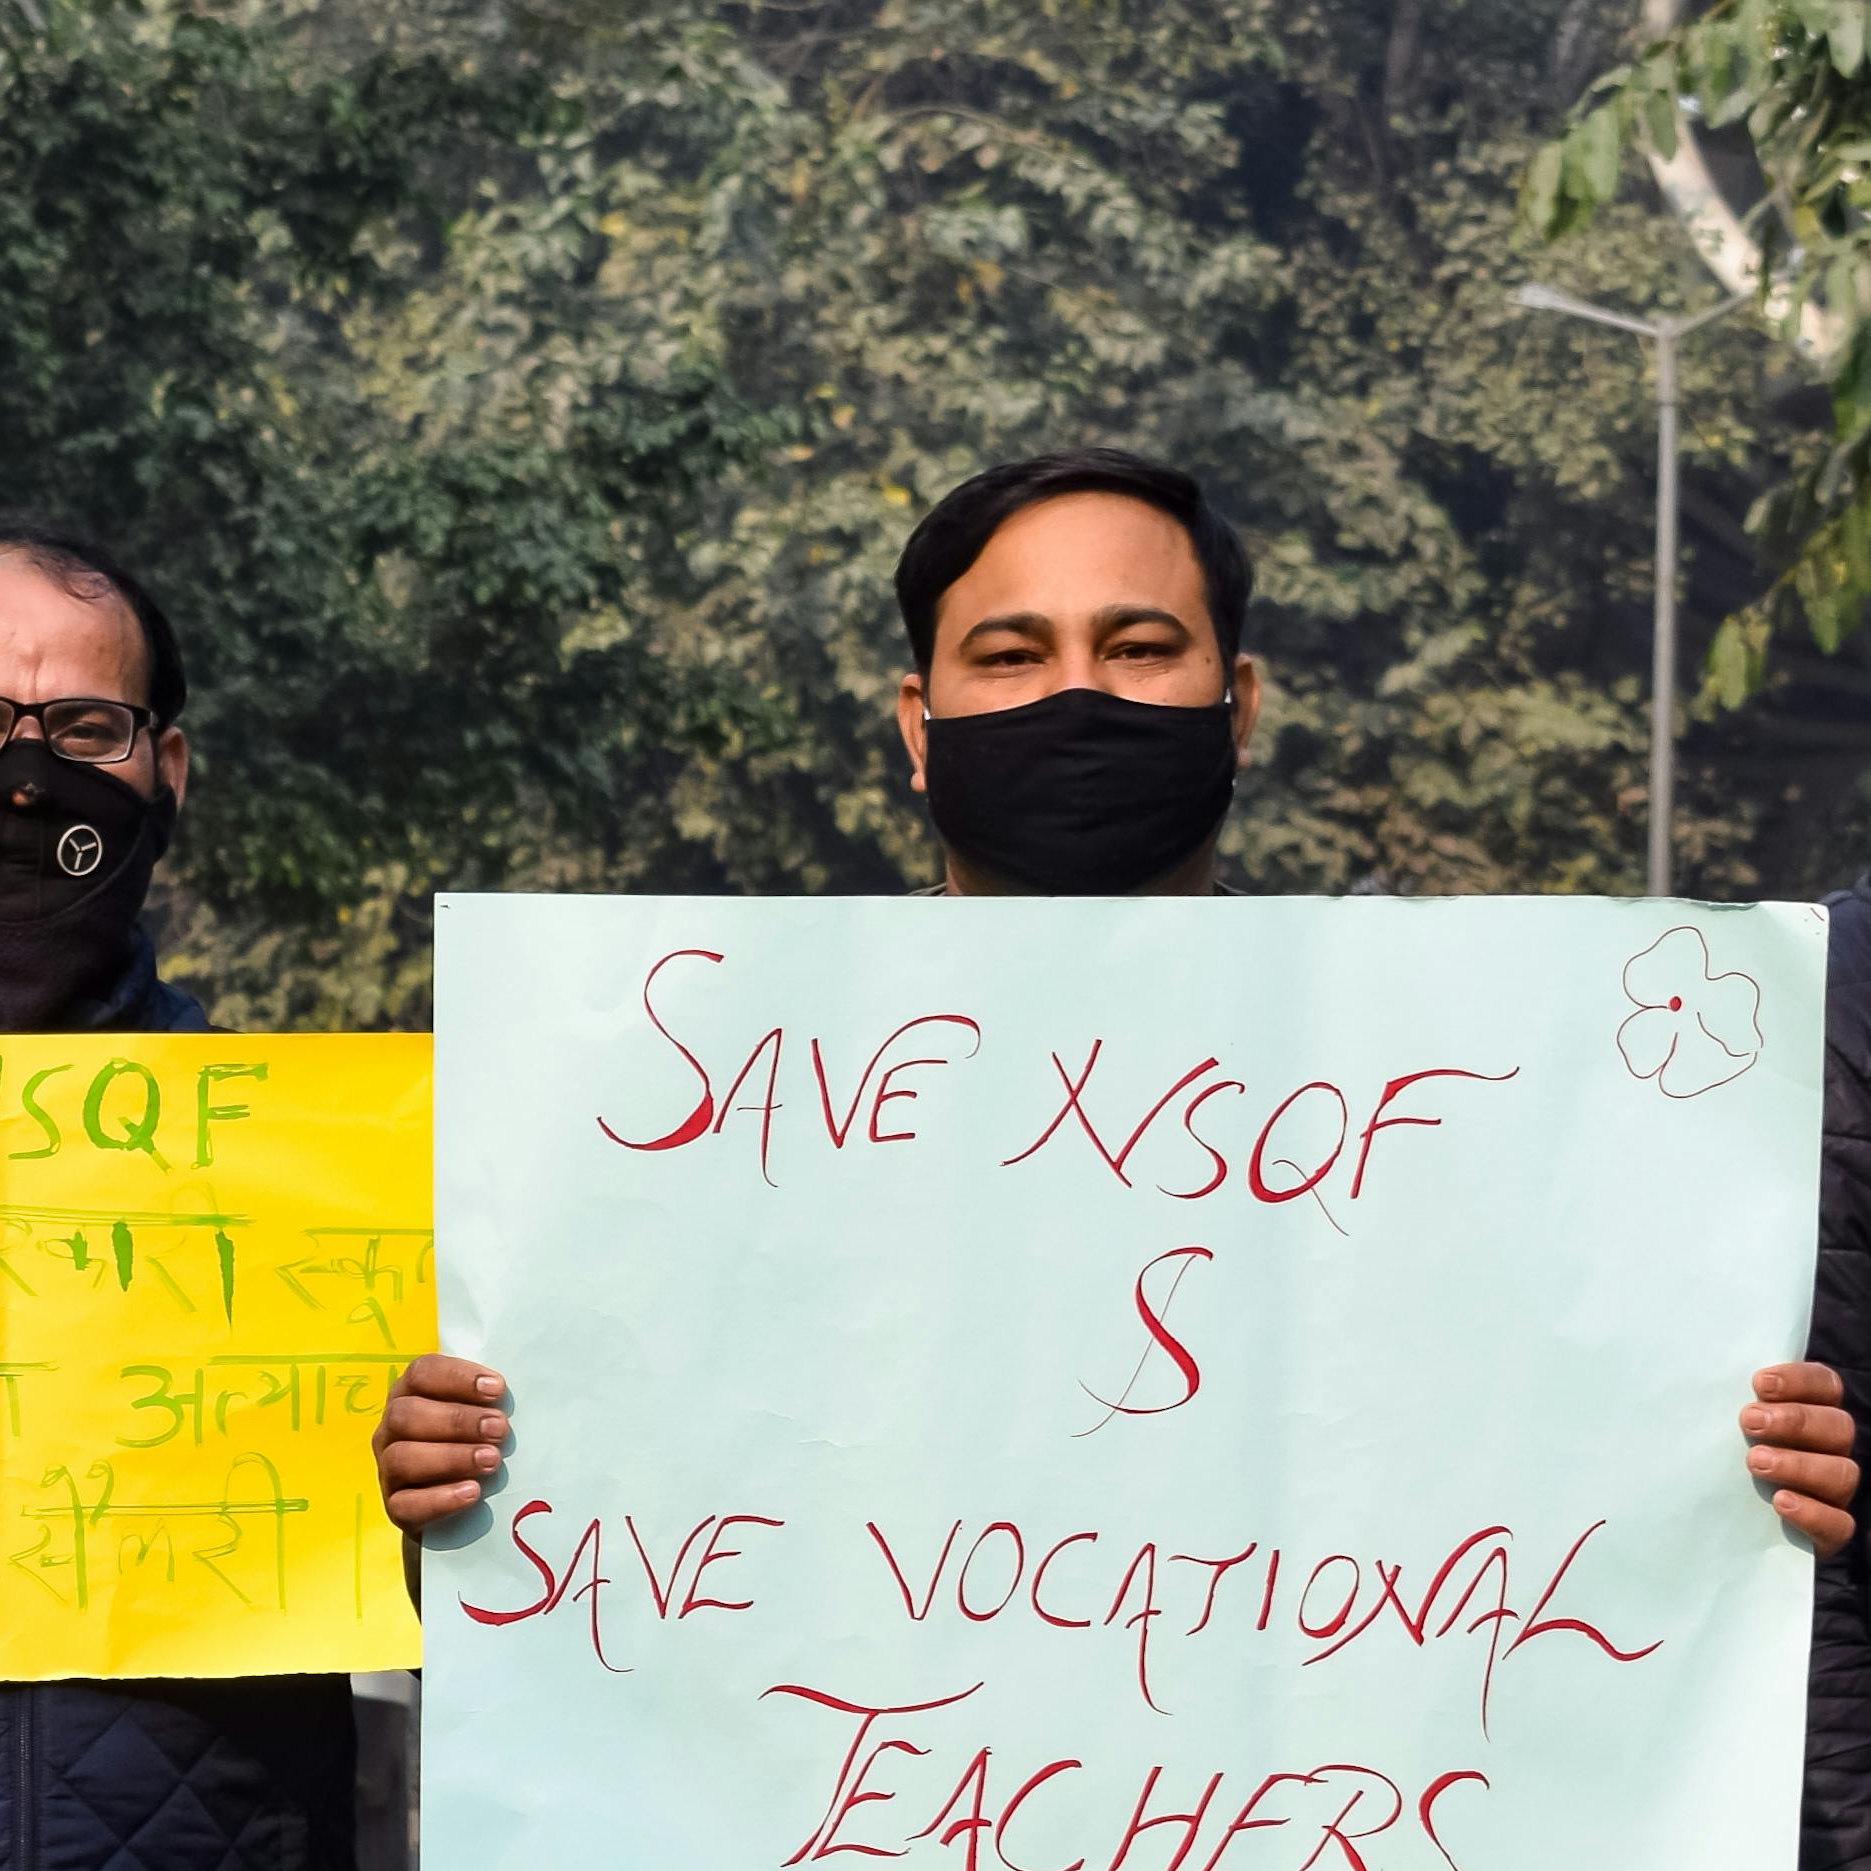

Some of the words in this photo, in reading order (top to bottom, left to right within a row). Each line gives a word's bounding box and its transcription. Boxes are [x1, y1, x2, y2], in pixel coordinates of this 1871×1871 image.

[597, 949, 980, 1187] SAVE
[1000, 1039, 1520, 1236] NSQF
[275, 1228, 434, 1350] स्कू
[458, 1501, 785, 1672] SAVE
[866, 1519, 1664, 1741] VOCATIONAL
